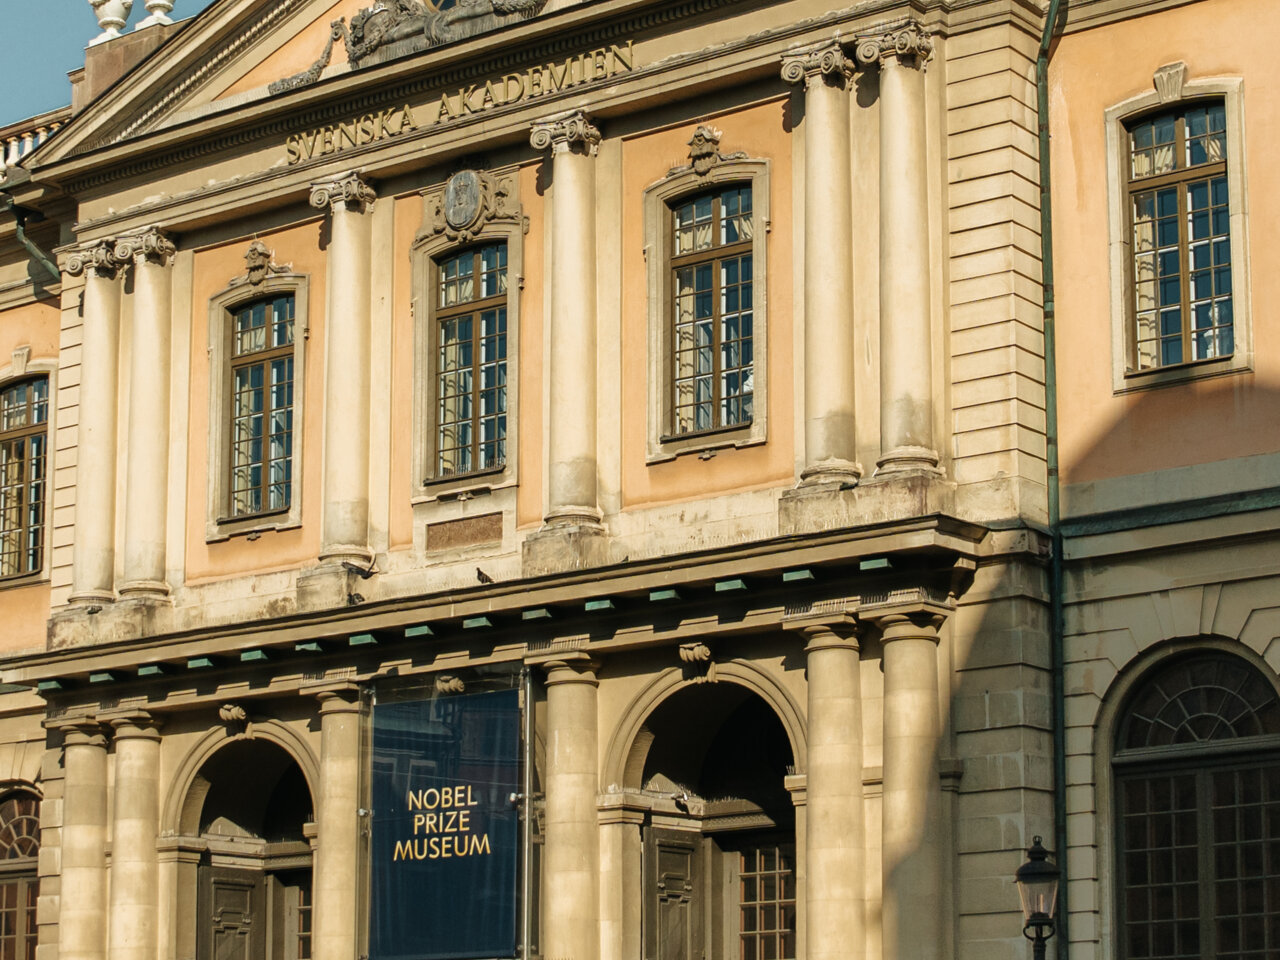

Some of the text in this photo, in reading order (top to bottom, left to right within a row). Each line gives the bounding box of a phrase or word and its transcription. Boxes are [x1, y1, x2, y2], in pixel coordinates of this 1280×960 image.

[286, 40, 634, 165] SVENSKA AKADEMIEN
[408, 785, 478, 811] NOBEL
[414, 811, 470, 835] PRIZE
[393, 833, 491, 862] MUSEUM
